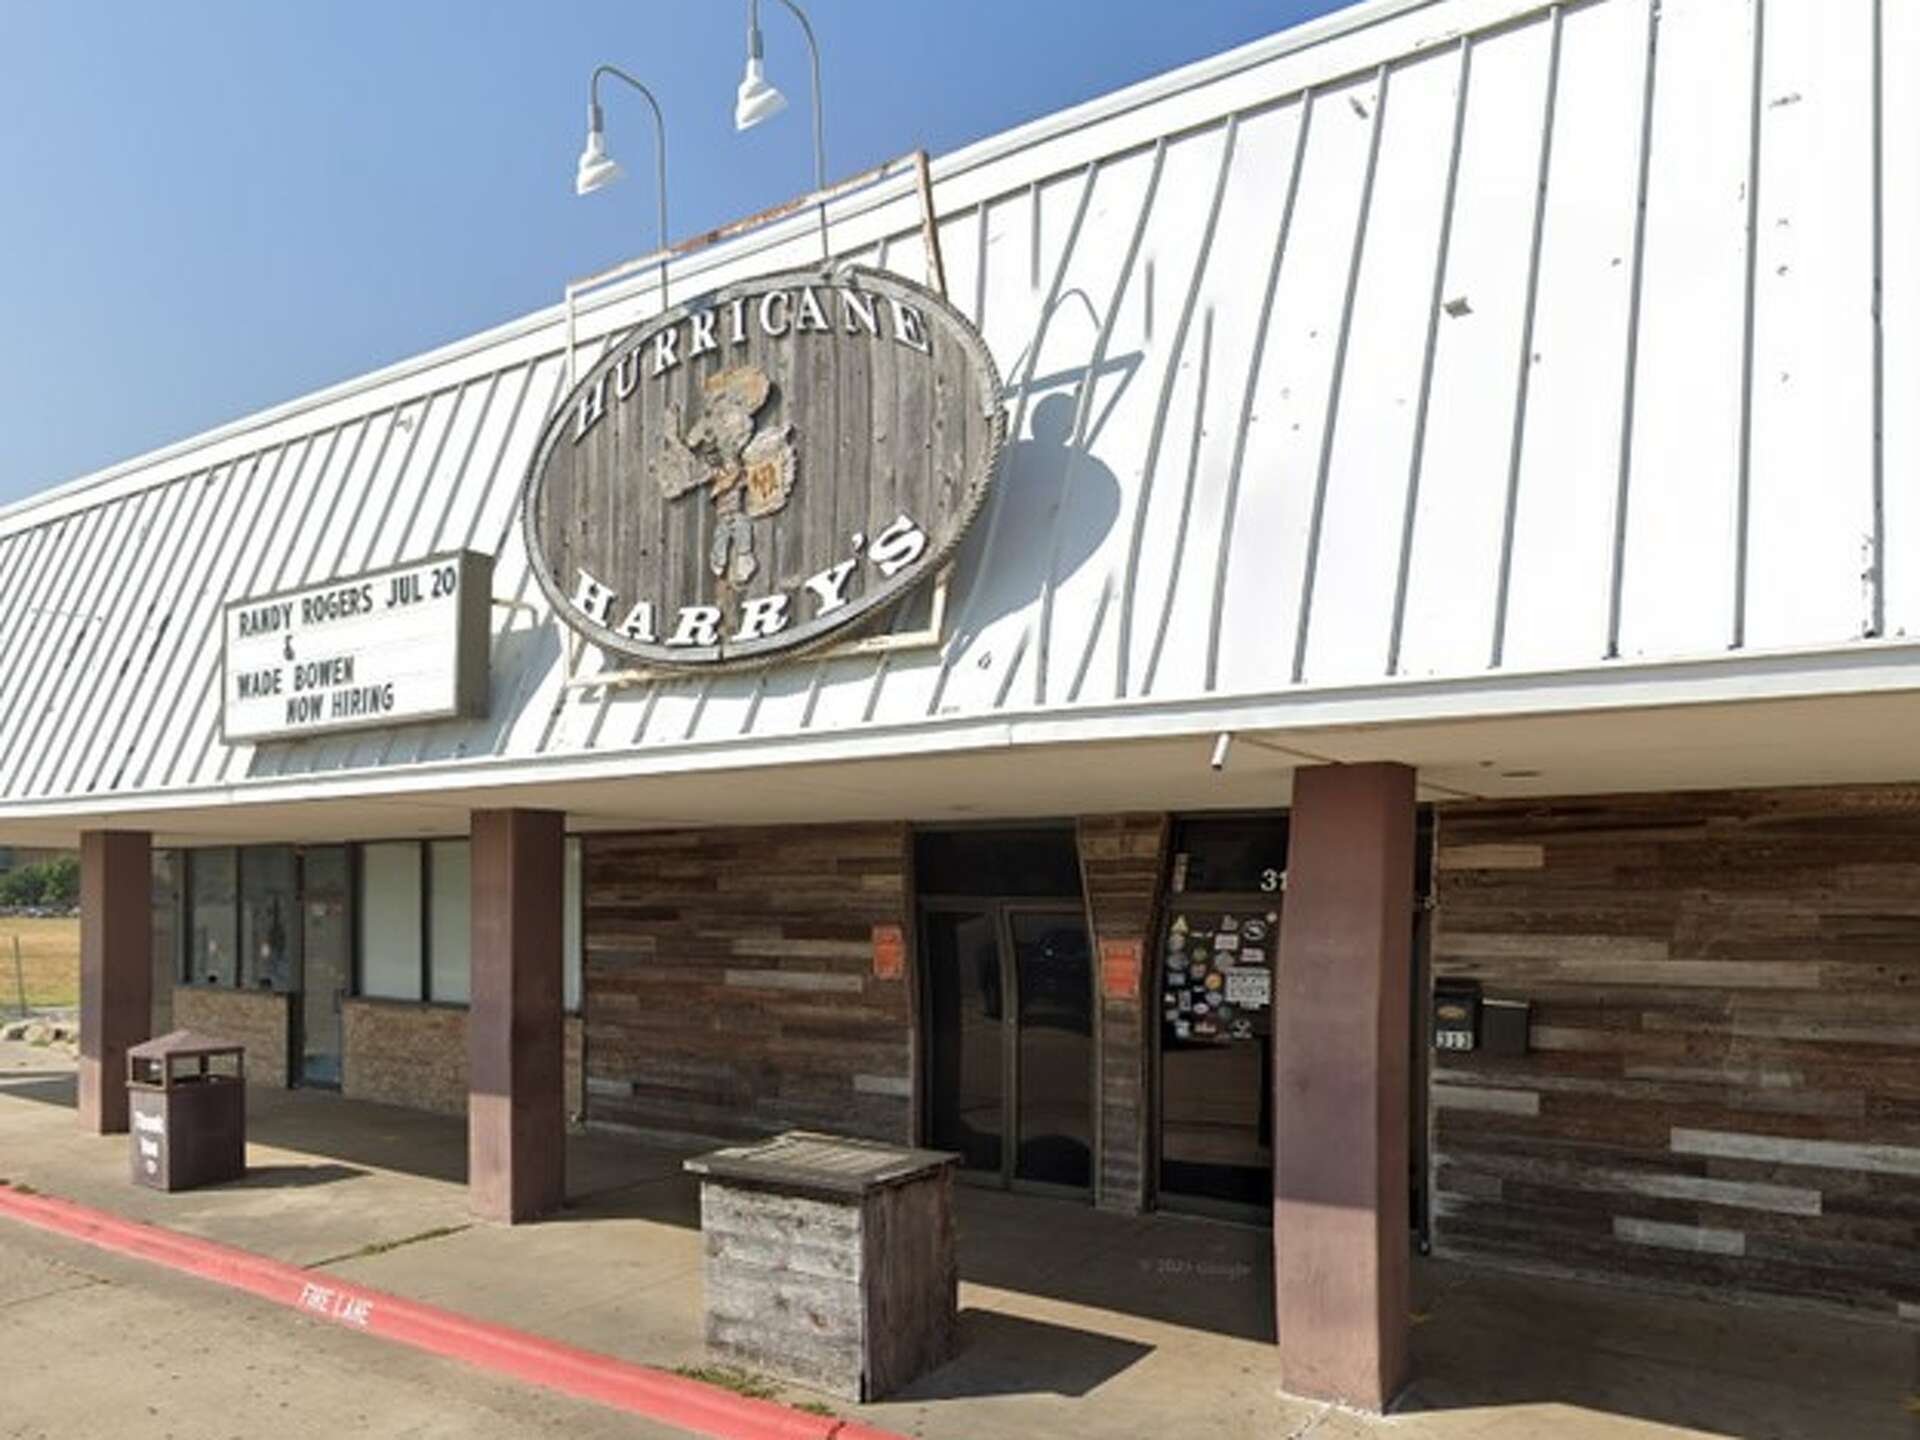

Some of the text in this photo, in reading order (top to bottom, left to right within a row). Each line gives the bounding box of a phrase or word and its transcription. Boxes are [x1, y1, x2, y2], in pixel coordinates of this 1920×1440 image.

[573, 285, 932, 444] HURRICANE
[569, 514, 928, 647] HARRY'S
[239, 566, 457, 638] RANDY ROGERS JUL 20
[283, 634, 295, 661] &
[237, 656, 354, 698] WADE BOWEN
[286, 683, 395, 724] NOW HIRING
[299, 1281, 335, 1313] FIRE
